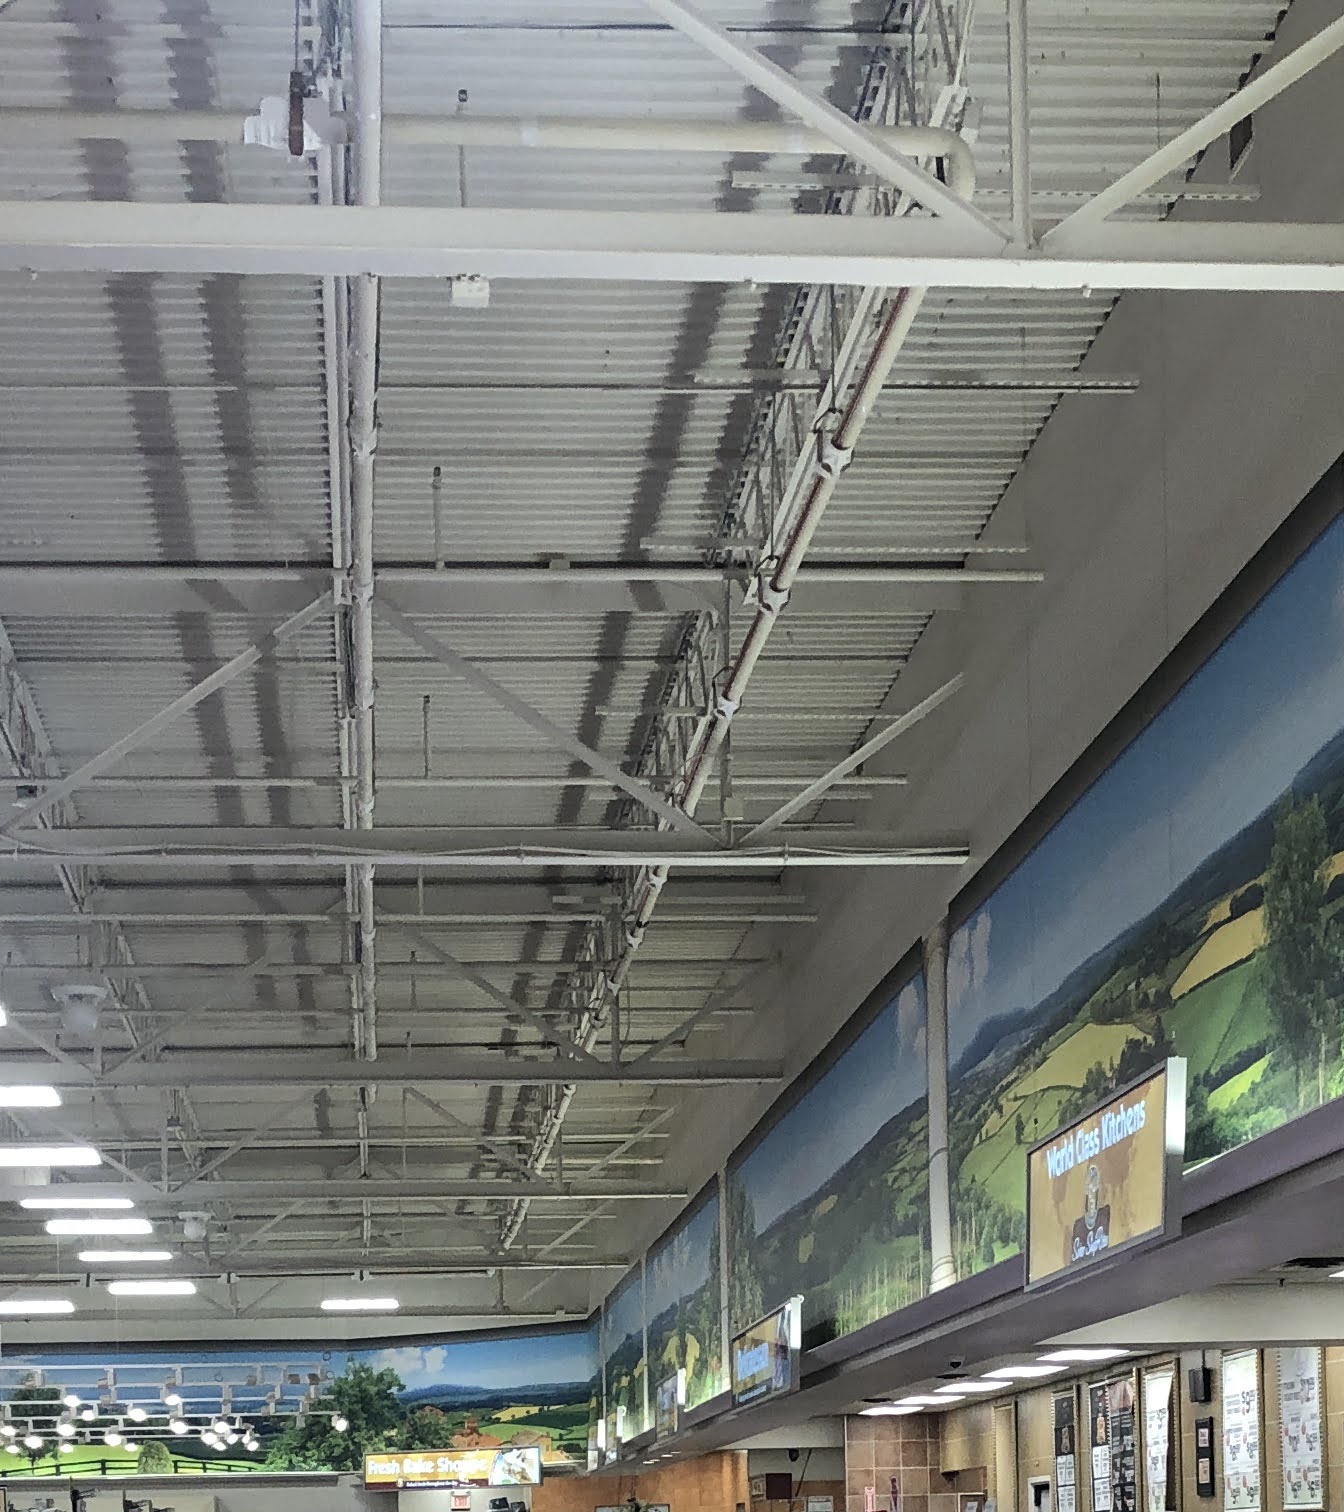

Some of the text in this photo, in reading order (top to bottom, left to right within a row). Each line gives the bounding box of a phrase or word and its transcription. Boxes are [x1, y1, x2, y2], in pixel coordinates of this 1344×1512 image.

[1046, 1099, 1146, 1181] World Class Kitchens
[368, 1458, 401, 1475] Fresh
